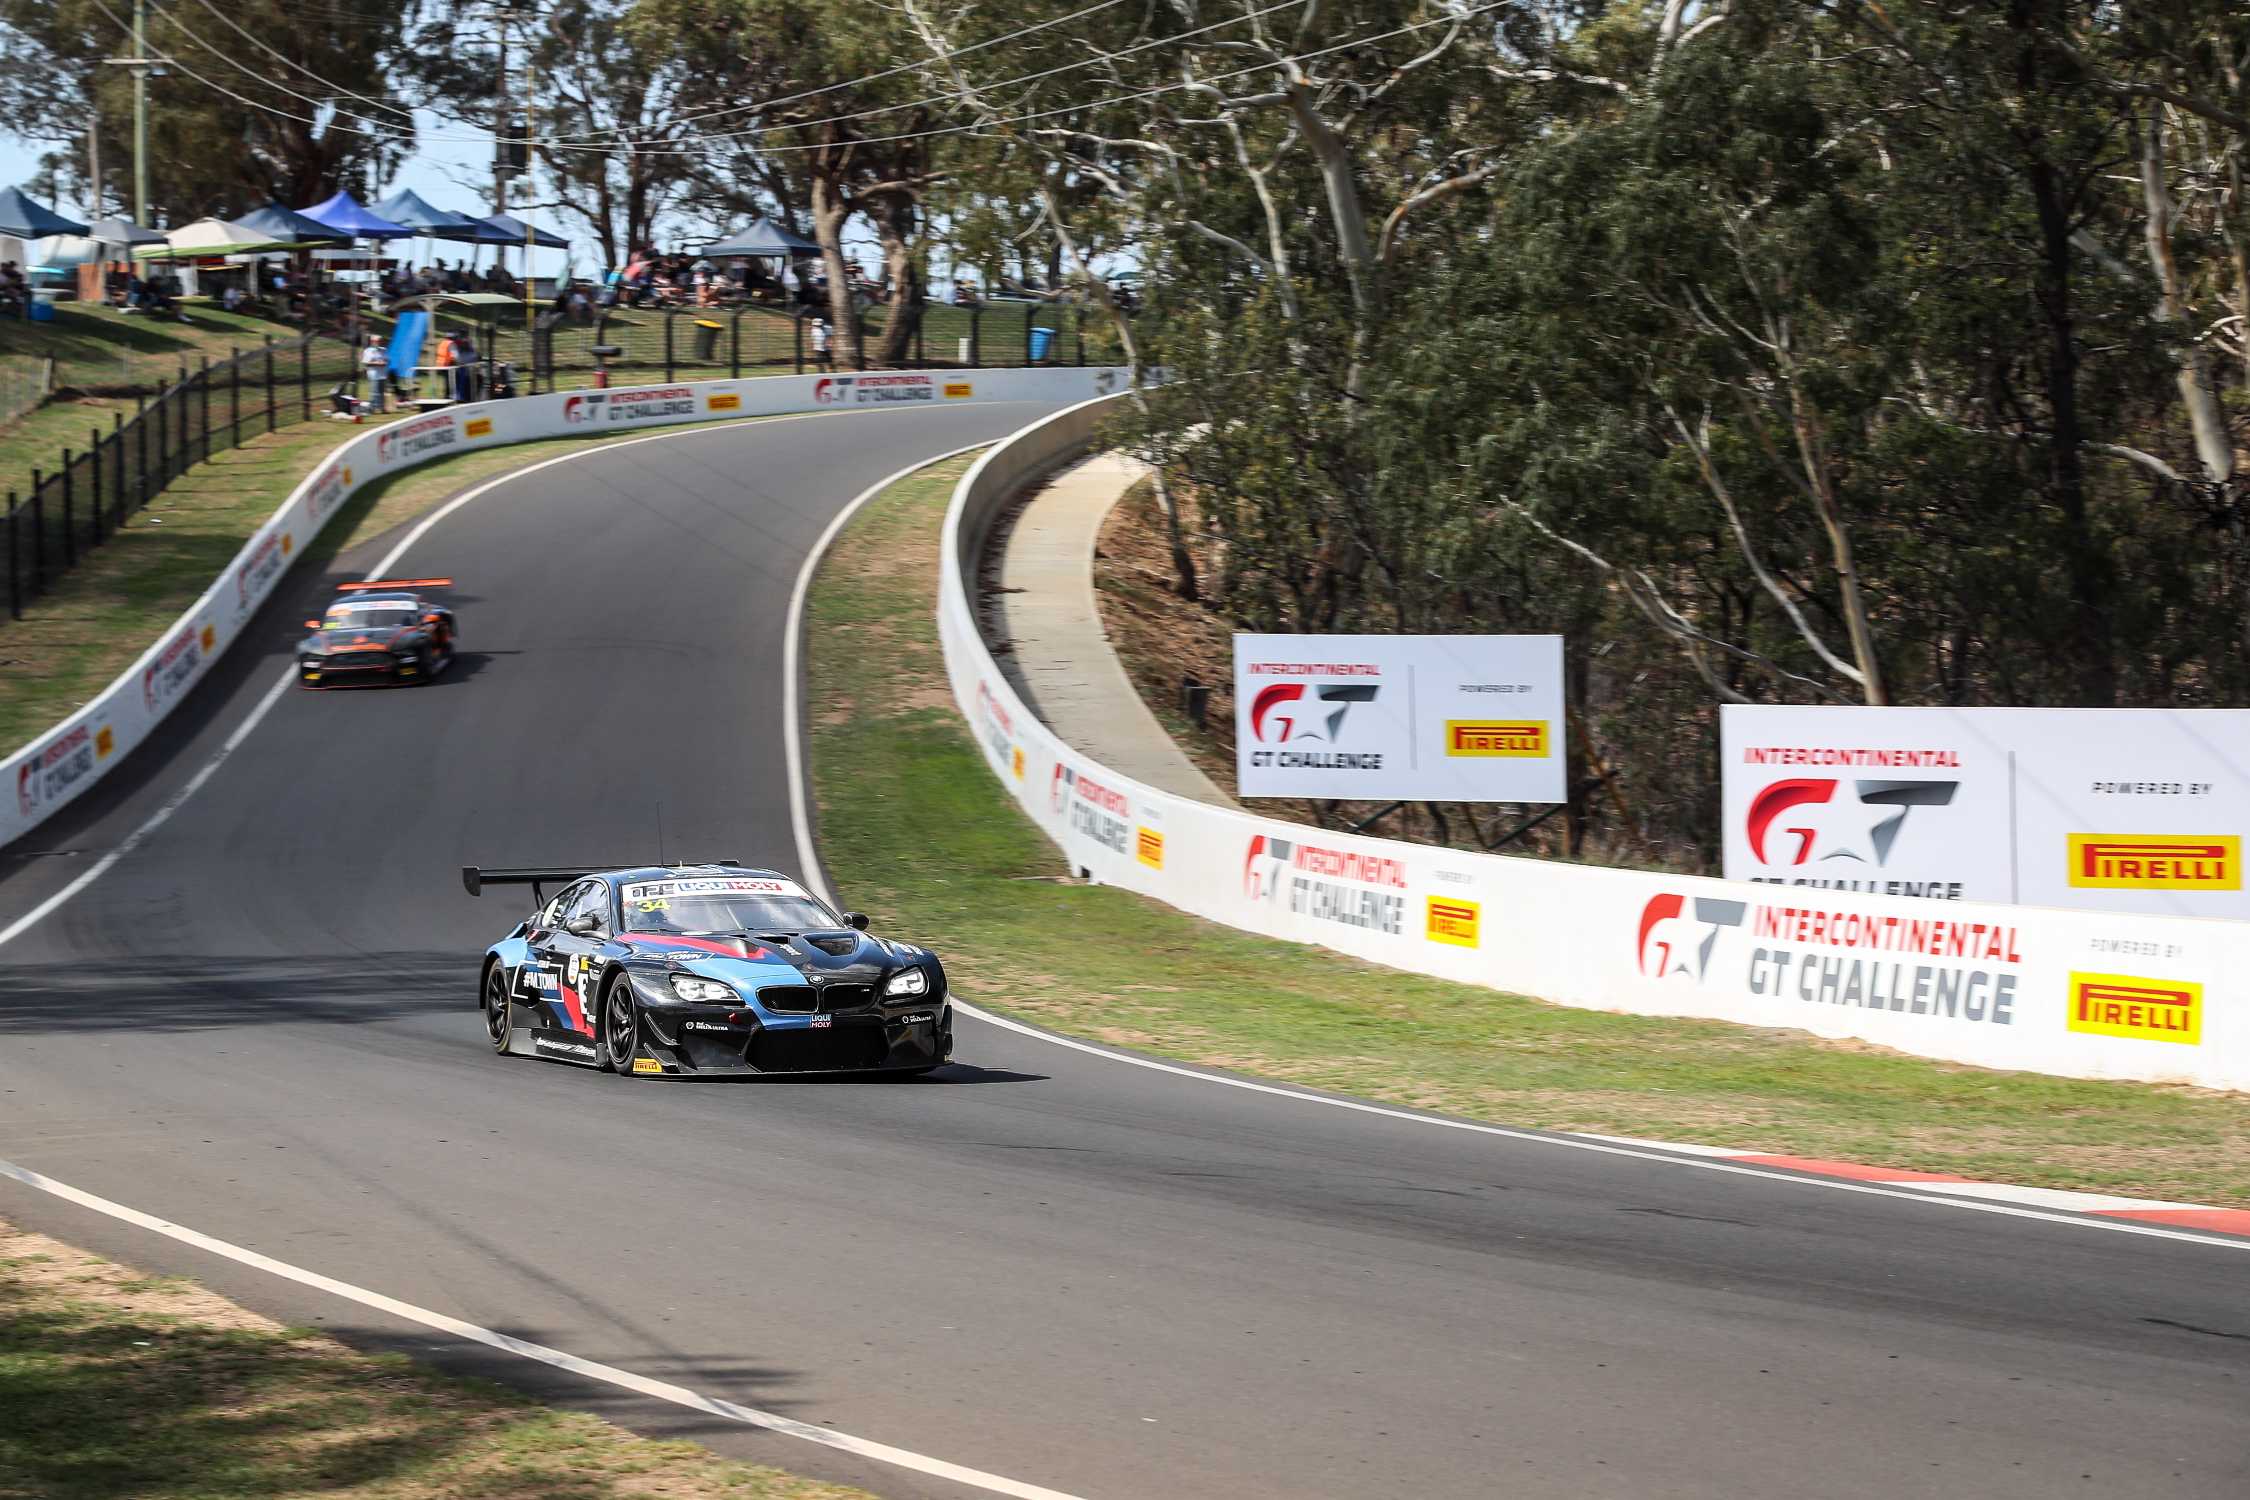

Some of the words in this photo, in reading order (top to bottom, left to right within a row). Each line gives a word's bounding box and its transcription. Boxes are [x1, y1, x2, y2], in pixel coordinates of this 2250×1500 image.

[1247, 663, 1381, 676] INTERCONTINENTAL
[1459, 684, 1514, 693] POWERED
[1454, 726, 1540, 750] PIRELLI
[1250, 751, 1273, 767] GT
[1278, 752, 1383, 769] CHALLENGE
[1744, 748, 1961, 767] INTERCONTINENTAL
[2092, 782, 2183, 794] POWERED
[2189, 783, 2213, 795] BY
[2083, 844, 2225, 879] PIRELLI
[733, 881, 778, 891] MOLY
[636, 899, 671, 913] 34
[1754, 905, 2021, 963] INTERCONTINENTAL
[2091, 938, 2159, 956] POWERED
[1748, 947, 1791, 996] GT
[1799, 954, 2018, 1025] CHALLENGE
[2078, 983, 2192, 1031] PIRELLI
